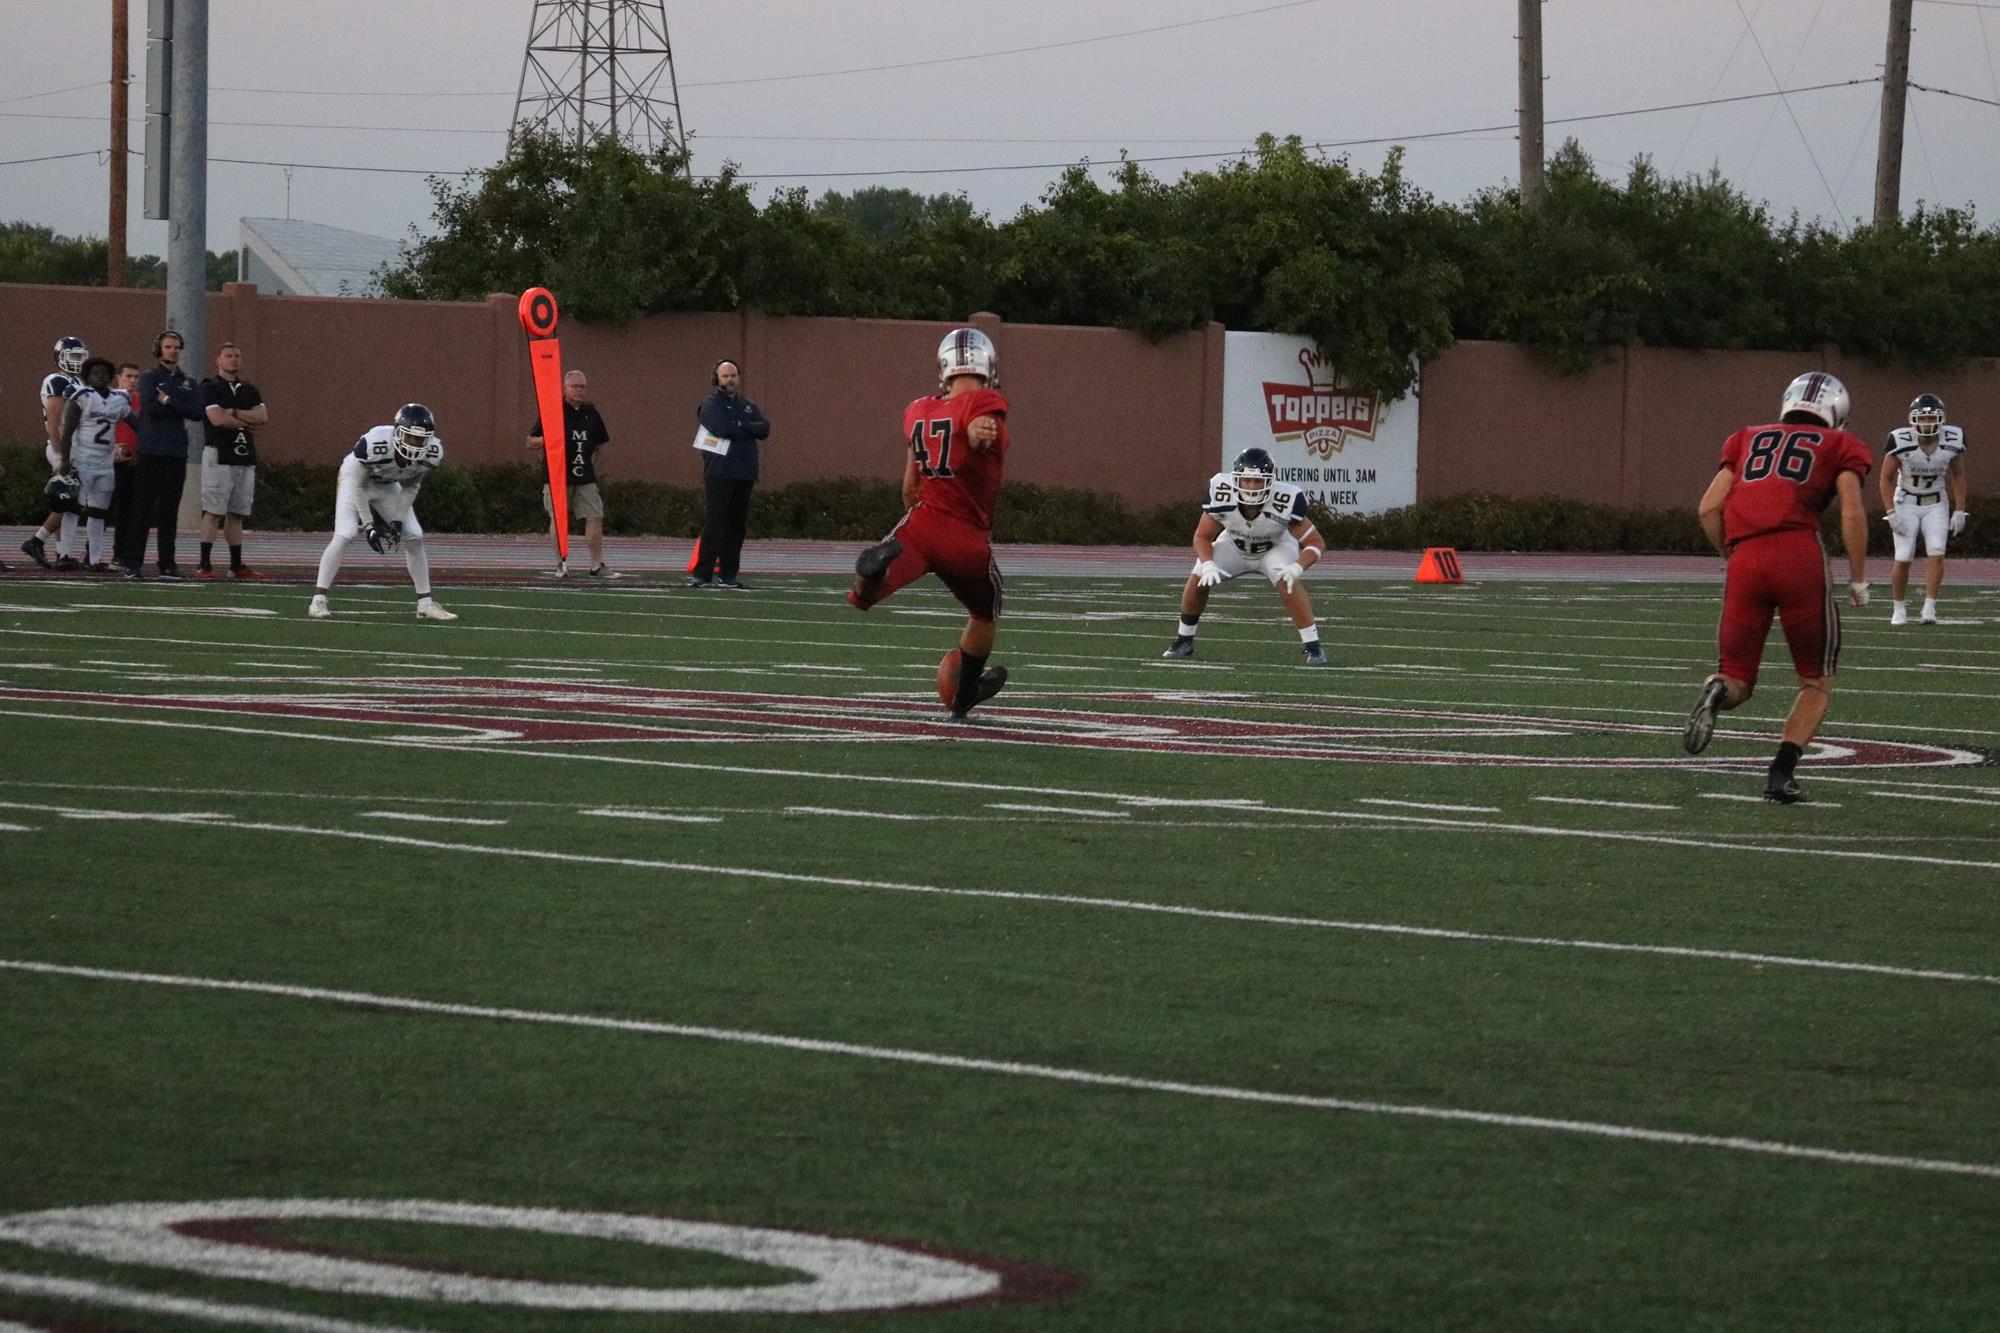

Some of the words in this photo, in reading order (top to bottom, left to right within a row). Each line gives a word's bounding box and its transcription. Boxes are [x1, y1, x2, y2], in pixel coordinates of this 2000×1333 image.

[1271, 394, 1371, 424] Toppers
[94, 419, 112, 446] 2
[1308, 429, 1338, 440] PIZZA
[1898, 431, 1913, 443] 17
[1944, 430, 1959, 443] 17
[373, 440, 389, 455] 18
[571, 430, 588, 477] MIAC
[910, 417, 956, 479] 47
[1741, 429, 1825, 485] 86
[1275, 467, 1320, 483] LIVERING
[1323, 468, 1352, 483] UNTIL
[1355, 469, 1377, 484] 3AM
[1910, 474, 1939, 489] 17
[1214, 482, 1233, 503] 46
[1272, 491, 1292, 514] 46
[1330, 491, 1359, 505] WEEK
[1433, 551, 1461, 579] 10
